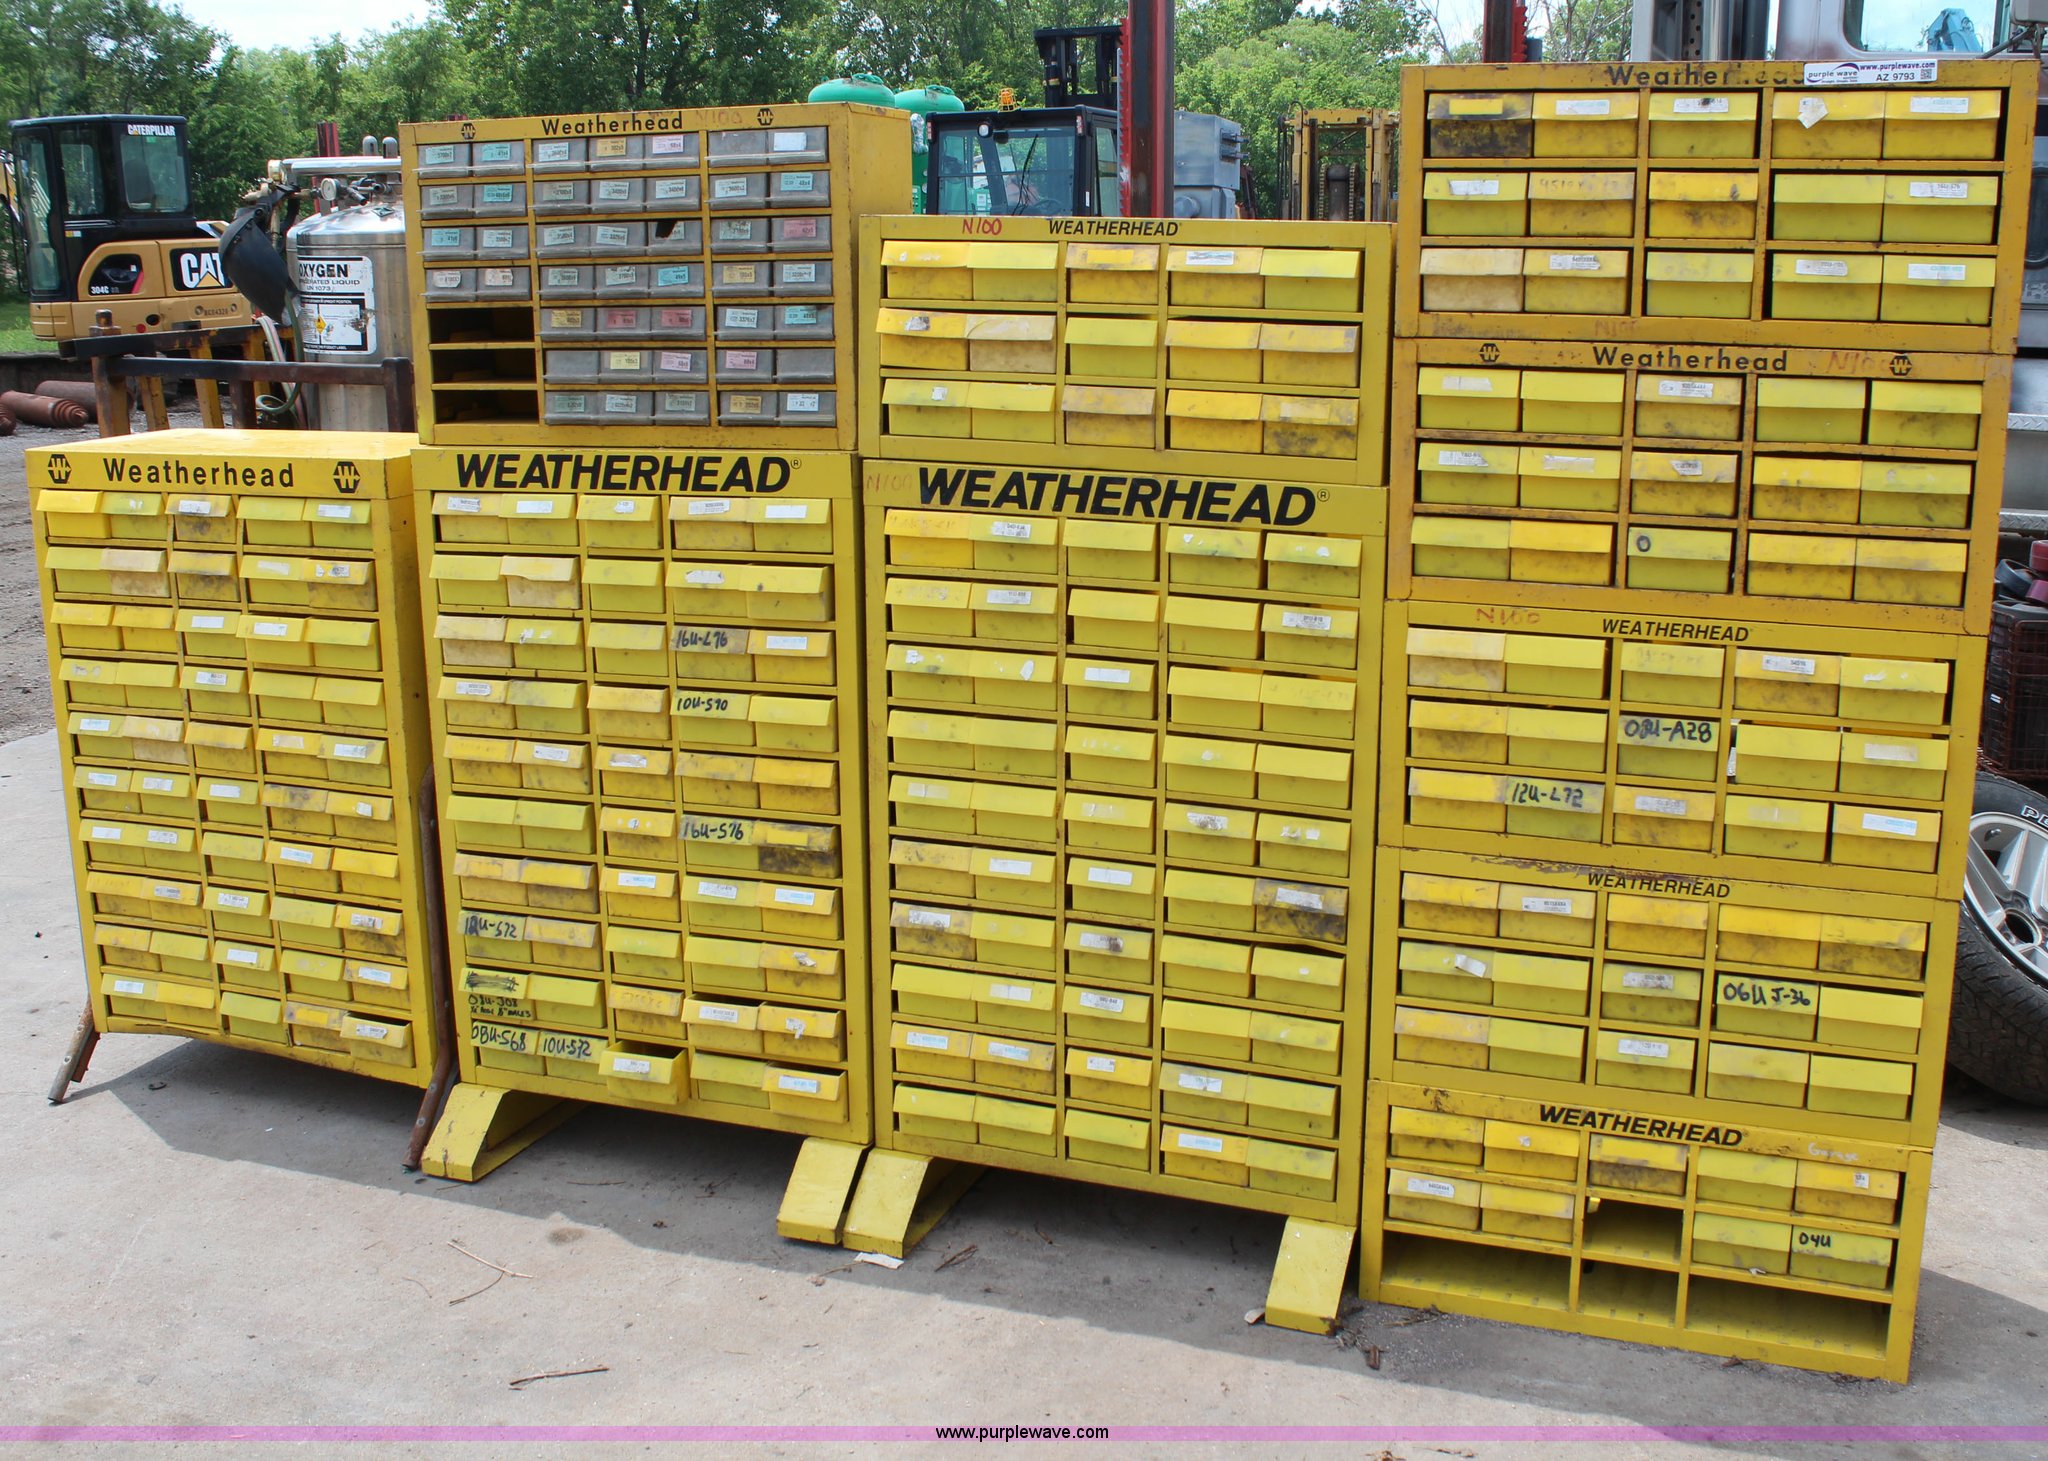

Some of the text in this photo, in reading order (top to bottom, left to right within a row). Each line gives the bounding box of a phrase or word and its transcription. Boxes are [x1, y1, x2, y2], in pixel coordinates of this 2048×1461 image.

[1808, 71, 1834, 79] purple
[1860, 61, 1936, 71] www.purplewave.com
[1876, 72, 1915, 82] AZ 9793
[128, 124, 175, 136] CATERPILLAR
[542, 111, 683, 135] Weatherhead
[962, 218, 1002, 235] N100
[1050, 220, 1179, 236] WEATHERHEAD
[180, 252, 225, 289] CAT
[91, 286, 109, 295] 304C
[1592, 346, 1787, 373] Weatherhead
[103, 458, 294, 488] Weatherhead
[1602, 618, 1750, 643] WEATHERHEAD
[1588, 872, 1731, 898] WEATHERHEAD
[1539, 1103, 1743, 1146] WEATHERHEAD
